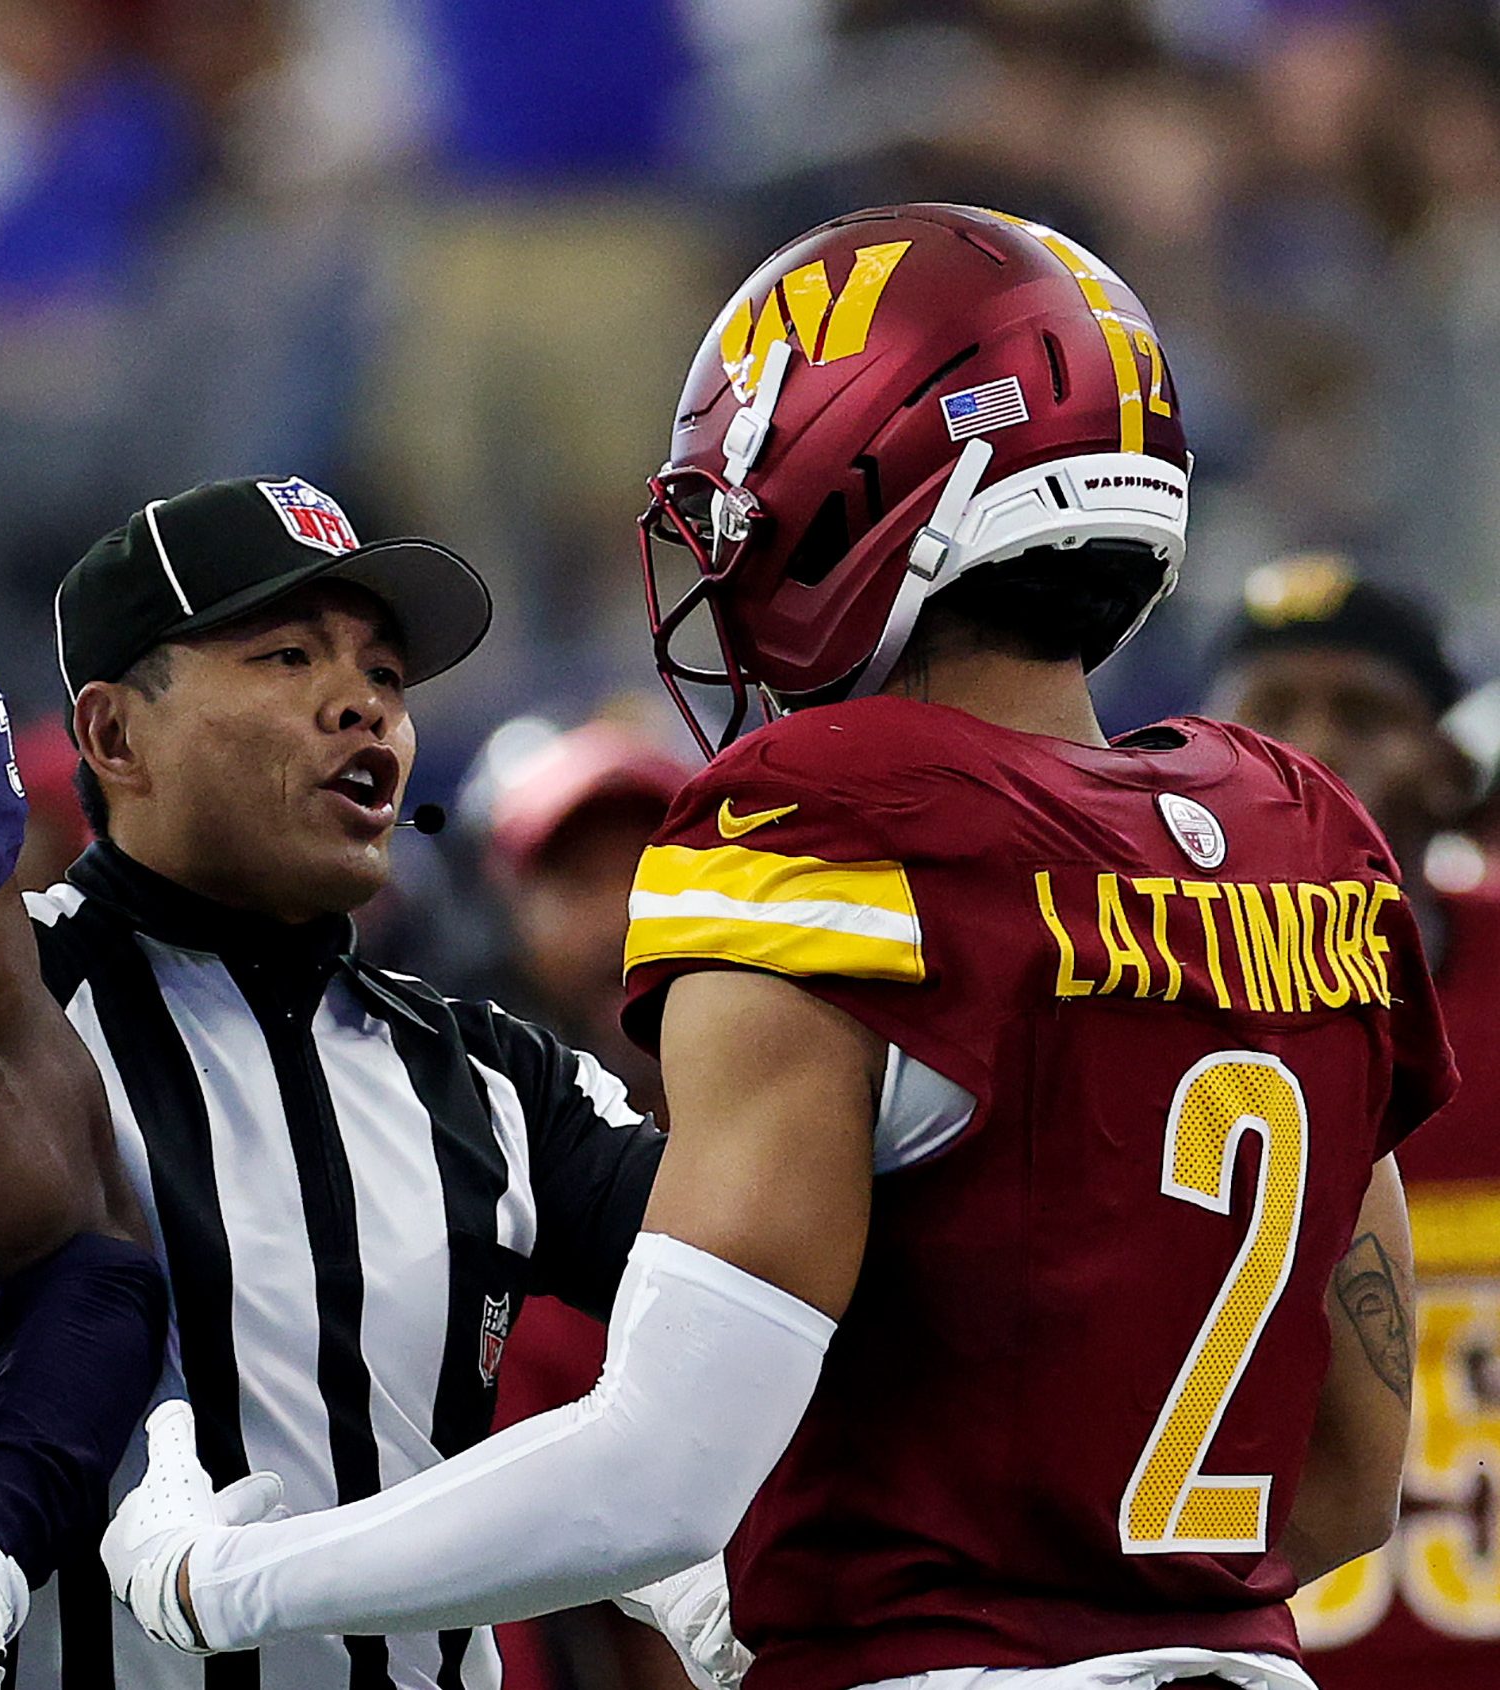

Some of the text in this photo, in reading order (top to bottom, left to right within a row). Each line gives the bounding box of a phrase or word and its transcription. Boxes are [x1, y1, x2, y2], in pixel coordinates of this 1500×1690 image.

[1133, 329, 1171, 419] 2
[284, 505, 356, 551] NFL
[1034, 870, 1401, 1012] LATTIMORE
[1120, 1050, 1308, 1554] 2
